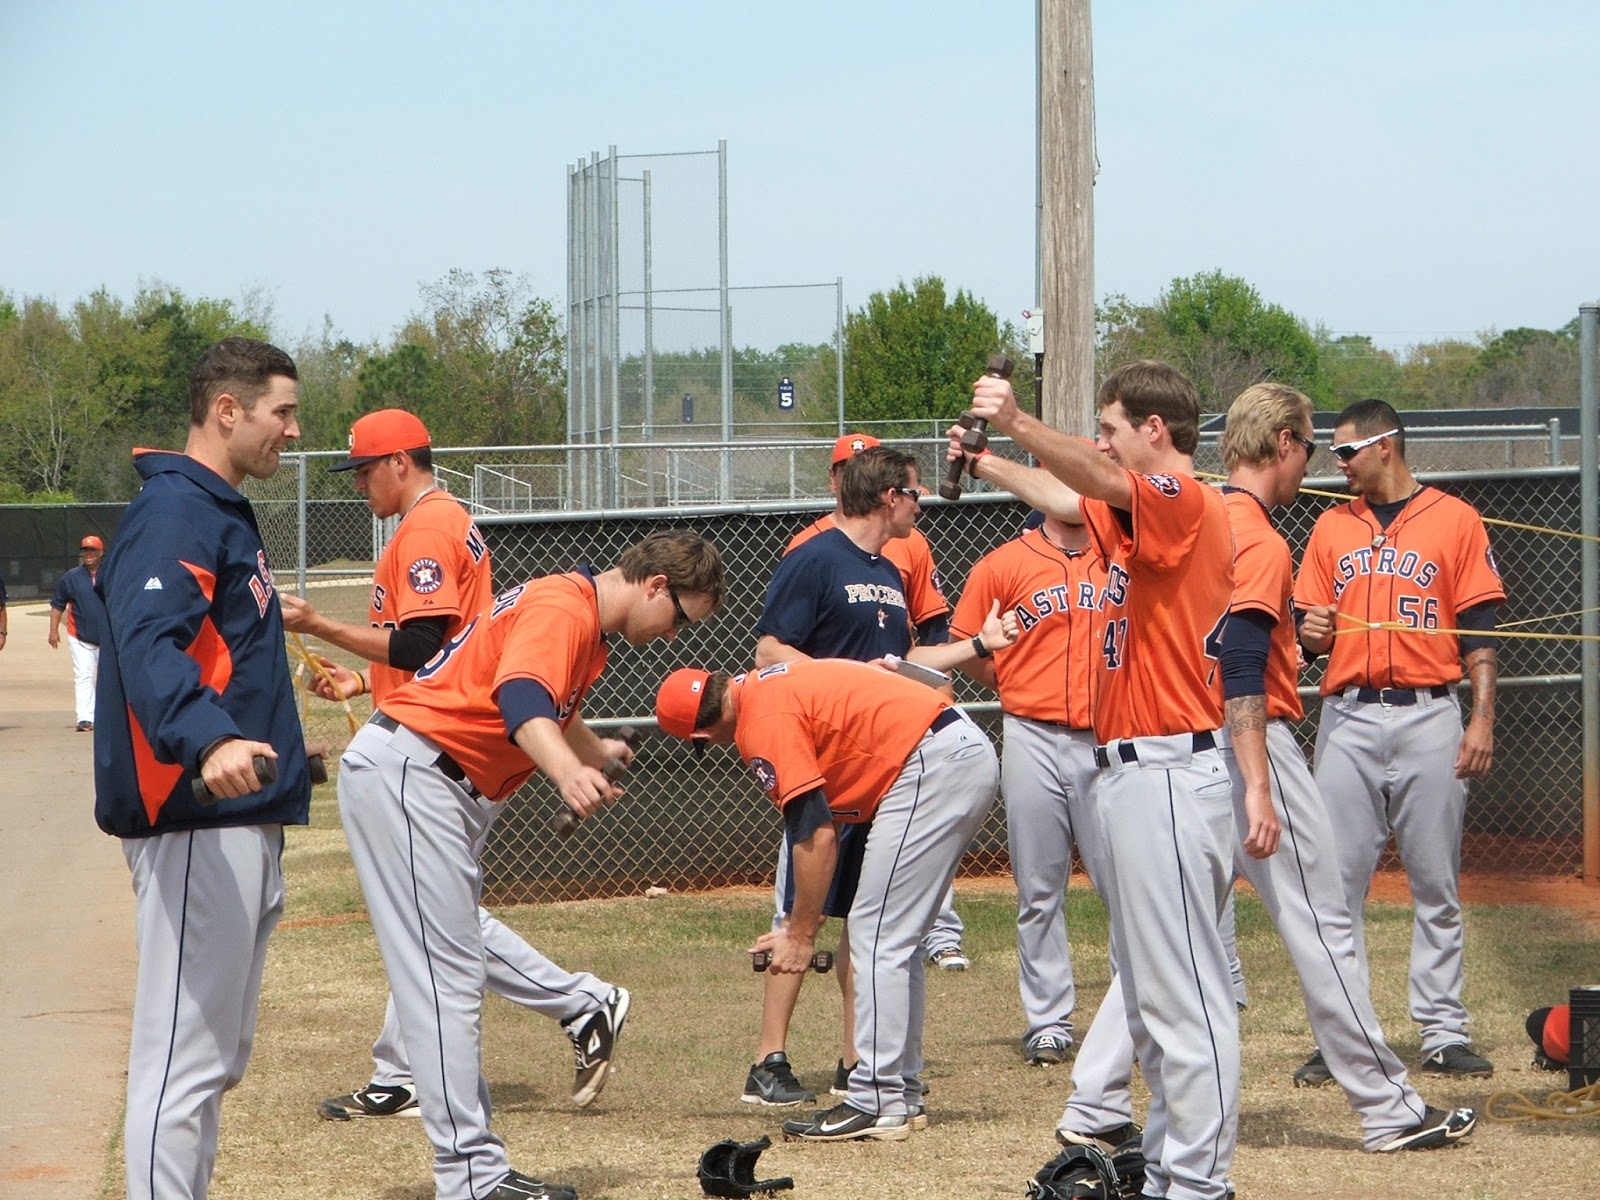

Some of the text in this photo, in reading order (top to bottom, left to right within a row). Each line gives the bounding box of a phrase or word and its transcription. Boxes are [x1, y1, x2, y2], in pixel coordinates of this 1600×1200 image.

[781, 392, 792, 406] 5
[409, 559, 438, 573] HOUSTON
[1333, 547, 1440, 601] ASTROS
[1397, 595, 1439, 635] 56
